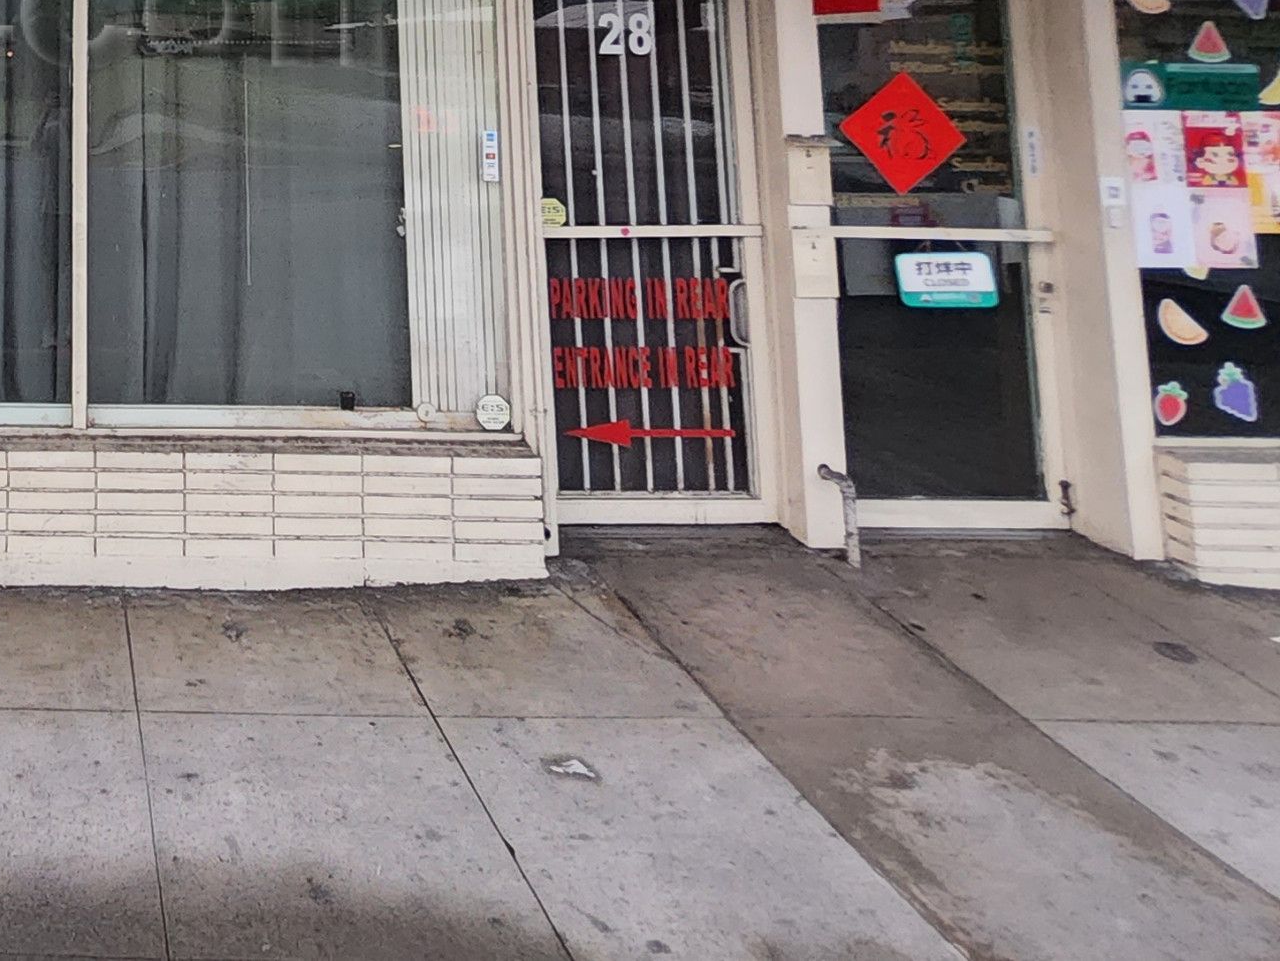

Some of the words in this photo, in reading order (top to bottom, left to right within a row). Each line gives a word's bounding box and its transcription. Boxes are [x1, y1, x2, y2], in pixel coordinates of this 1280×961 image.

[598, 12, 653, 56] 28
[876, 108, 937, 161] 福
[549, 277, 638, 319] PARKING
[645, 277, 669, 319] IN
[675, 277, 730, 319] REAR
[553, 346, 652, 389] ENTRANCE
[658, 346, 679, 388] IN
[684, 346, 736, 388] REAR
